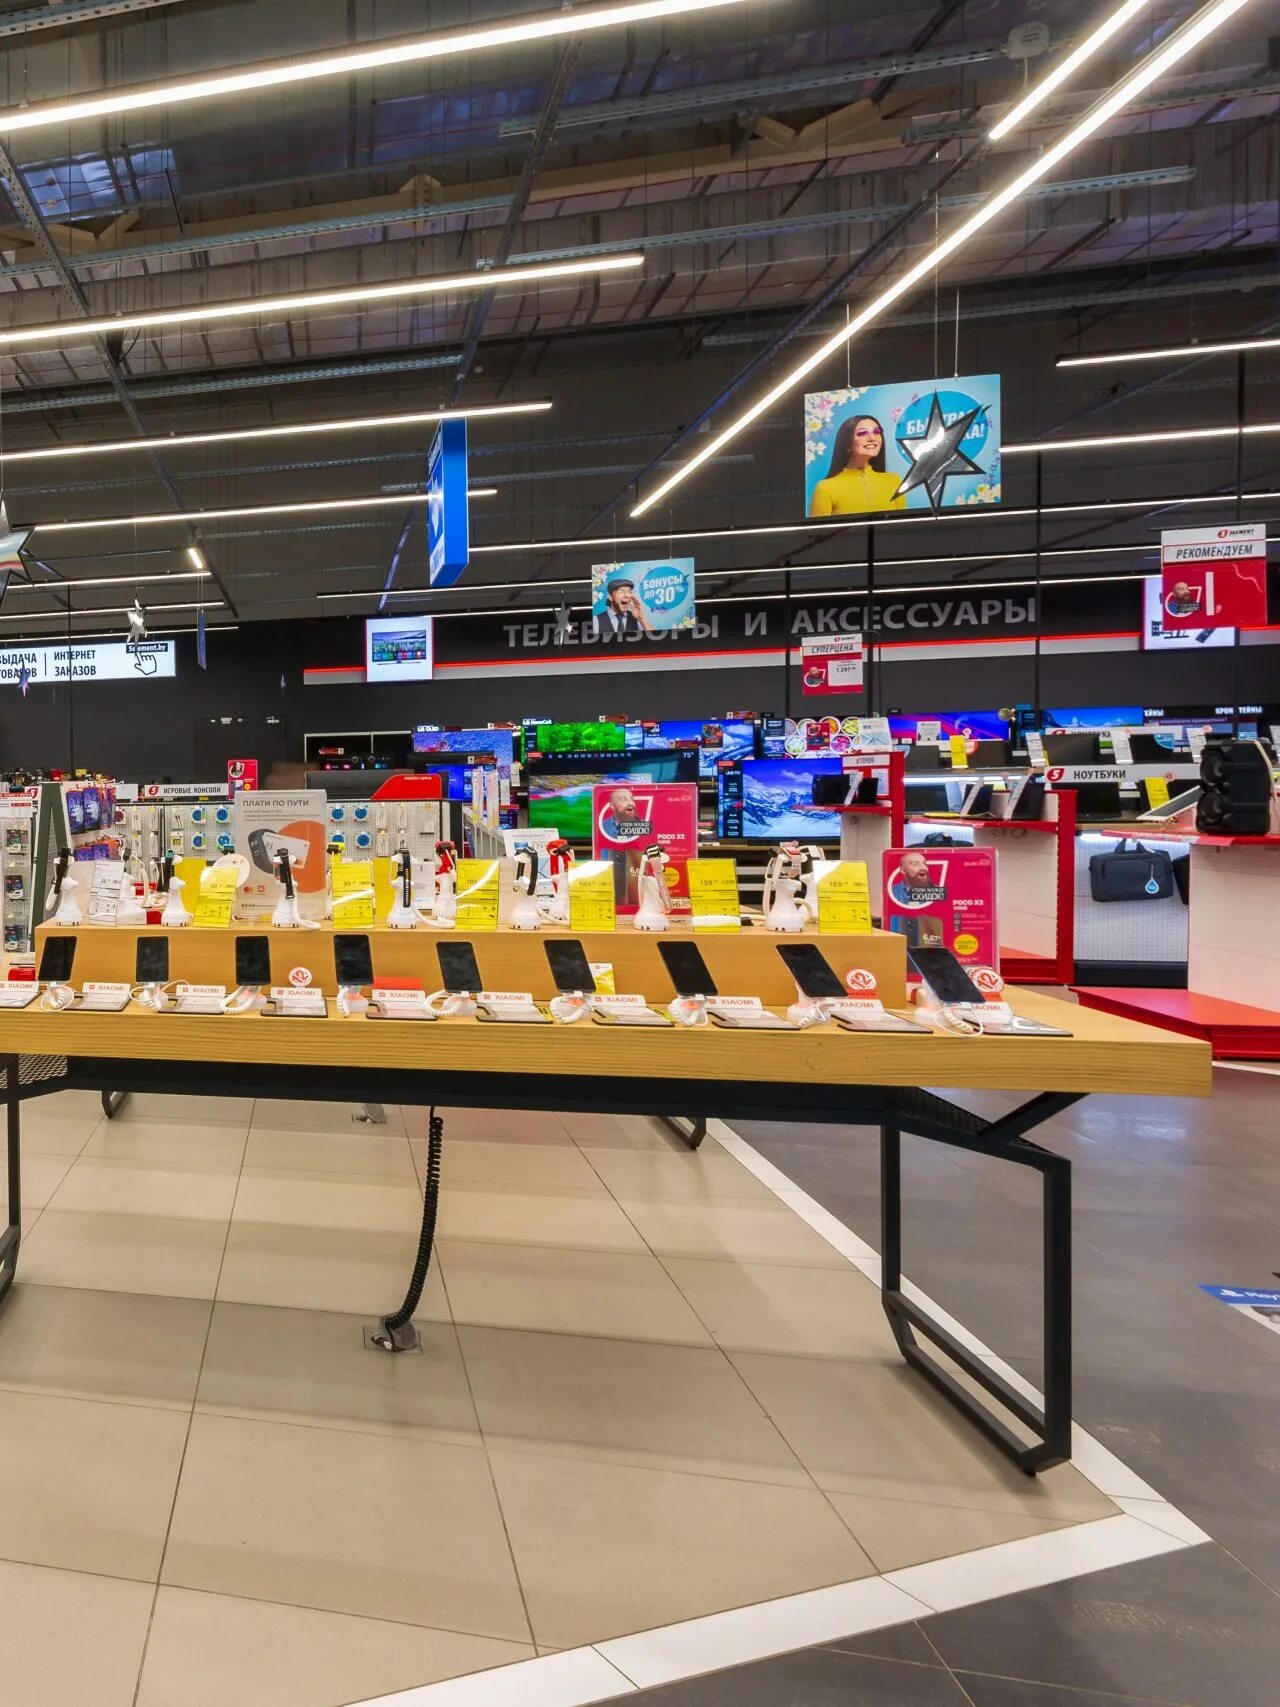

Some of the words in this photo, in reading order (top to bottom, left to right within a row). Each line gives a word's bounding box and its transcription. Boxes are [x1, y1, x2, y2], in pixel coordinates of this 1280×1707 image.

[1176, 544, 1253, 559] РЕКОМЕНДУЕМ
[643, 574, 684, 591] БОНУСЫ
[744, 612, 767, 636] И
[790, 598, 1036, 634] АКСЕССУАРЫ
[811, 644, 854, 654] СУПЕРЦЕНА
[1074, 770, 1126, 780] НОУТБУКИ
[620, 827, 650, 835] СКИДОК!
[912, 892, 944, 901] СКИДОК!
[292, 970, 309, 984] 12
[852, 973, 872, 988] 12
[978, 973, 997, 990] 12
